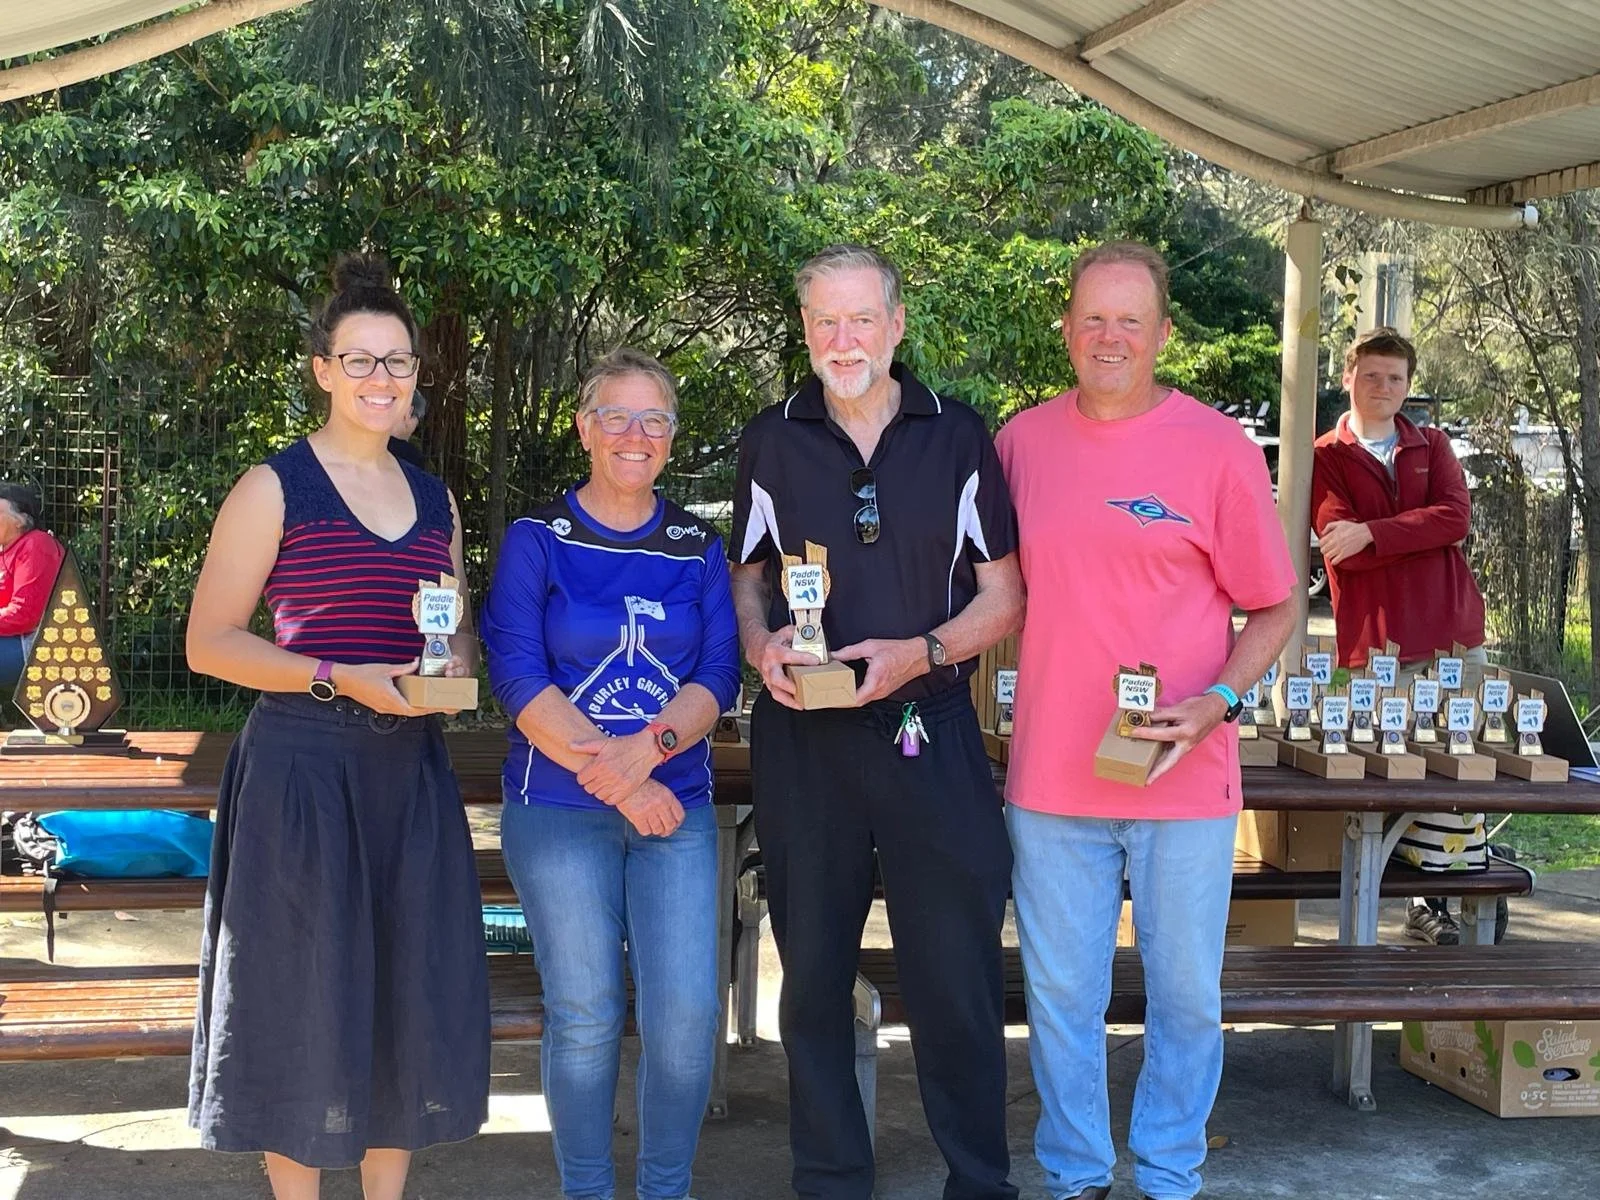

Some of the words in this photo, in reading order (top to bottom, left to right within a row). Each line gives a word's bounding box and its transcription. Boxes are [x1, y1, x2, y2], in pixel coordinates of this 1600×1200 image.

[790, 570, 820, 579] Paddle
[794, 579, 817, 587] NSW
[424, 594, 454, 603] Paddle
[427, 603, 450, 612] NSW
[1122, 678, 1153, 687] Paddle
[1126, 685, 1148, 693] NSW
[589, 677, 630, 713] BURLEY
[637, 677, 669, 708] GRIFFI
[1537, 1025, 1577, 1053] Salad
